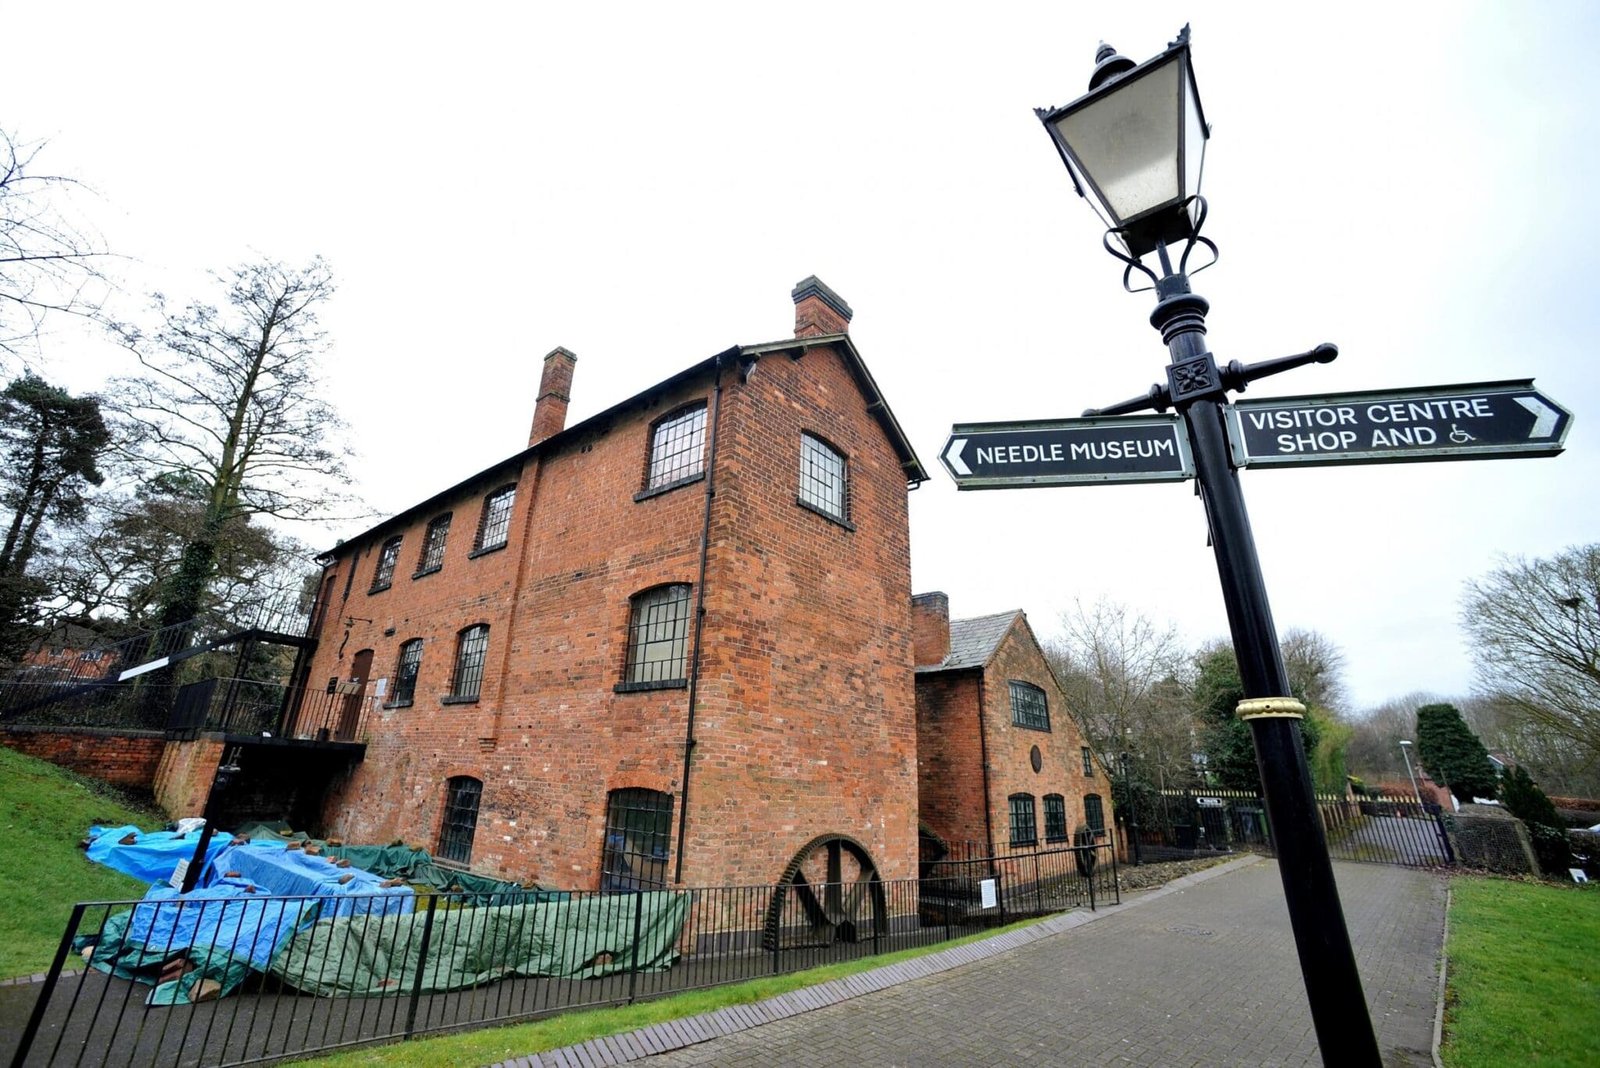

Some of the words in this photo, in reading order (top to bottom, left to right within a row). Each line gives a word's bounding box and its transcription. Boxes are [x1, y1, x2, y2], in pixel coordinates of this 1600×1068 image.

[1248, 407, 1358, 430] VISITOR
[1366, 398, 1494, 424] CENTRE
[976, 443, 1064, 465] NEEDLE
[1070, 439, 1175, 461] MUSEUM
[1277, 430, 1357, 453] SHOP
[1371, 426, 1437, 448] AND
